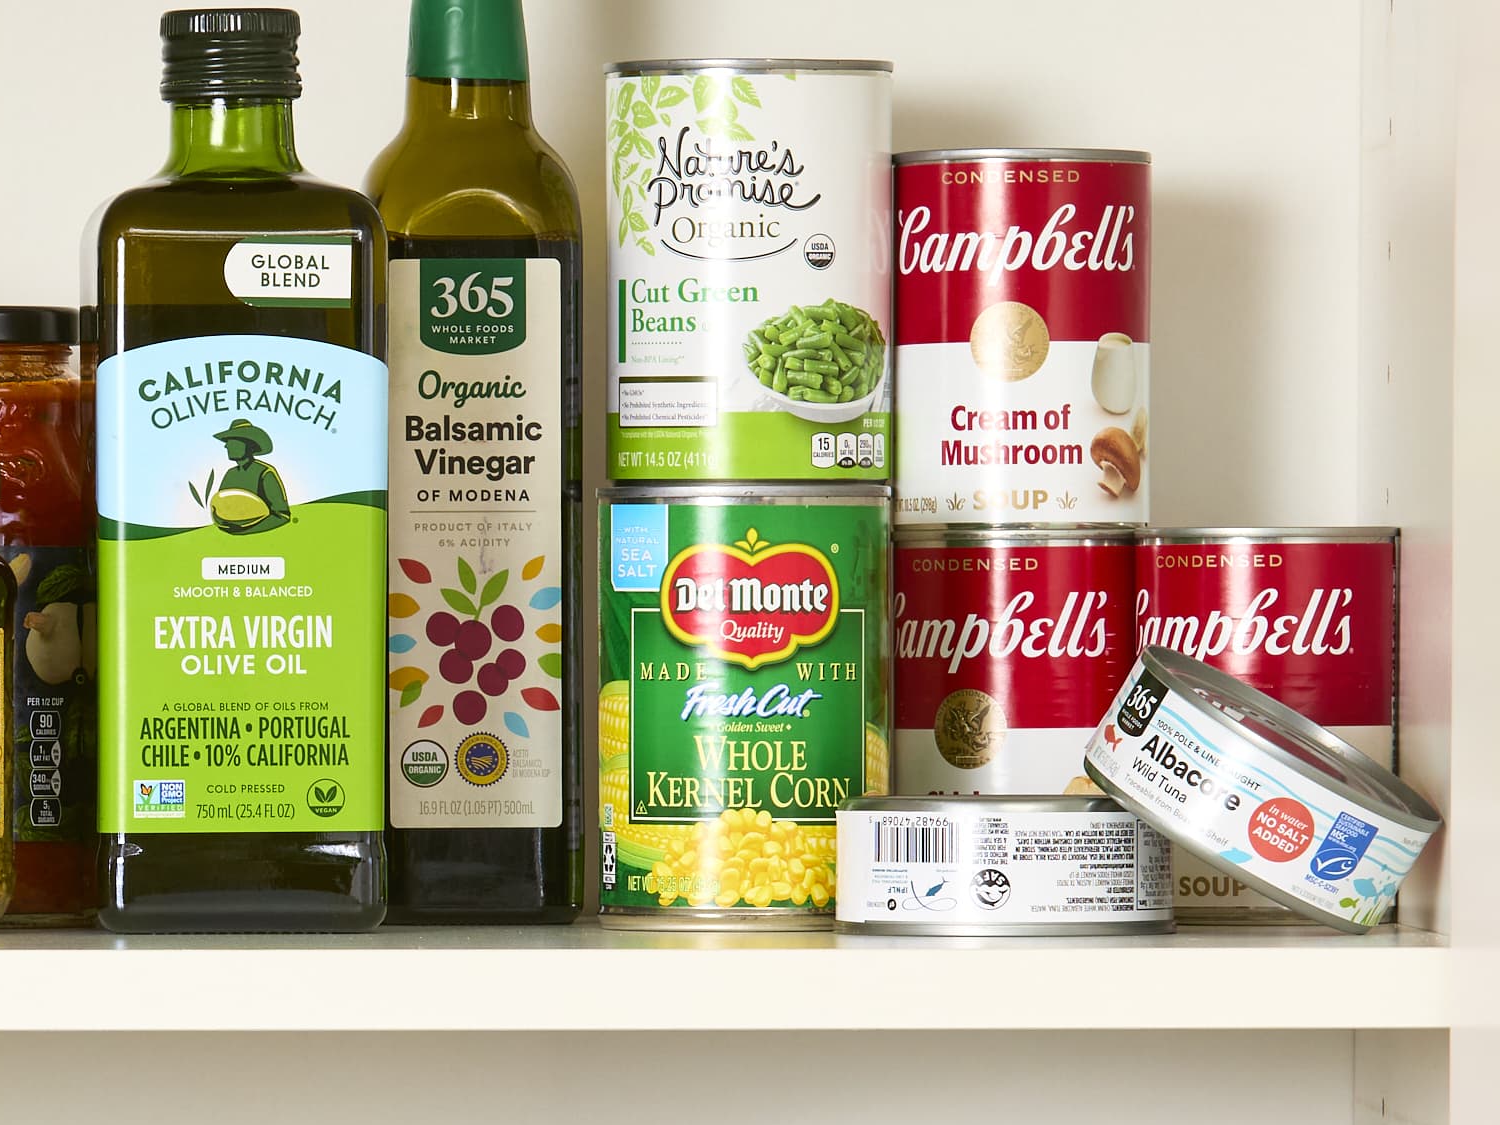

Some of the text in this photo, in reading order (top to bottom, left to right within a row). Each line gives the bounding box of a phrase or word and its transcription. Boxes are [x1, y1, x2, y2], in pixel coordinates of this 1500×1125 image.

[941, 170, 1080, 184] CONDENSED
[898, 203, 1135, 287] Campbell's
[251, 254, 330, 270] GLOBAL
[261, 273, 320, 288] BLEND
[631, 278, 669, 303] Cut
[430, 272, 514, 318] 365
[431, 325, 514, 333] WHOLE FOODS
[631, 309, 697, 333] Beans
[450, 336, 496, 344] MARKET
[138, 360, 341, 403] CALIFORNIA
[418, 370, 526, 408] Organic
[151, 389, 336, 430] OLIVE RANCH
[951, 404, 1070, 431] Cream of
[405, 415, 542, 442] Balsamic
[941, 440, 1082, 465] Mushroom
[415, 449, 535, 481] Vinegar
[417, 490, 530, 501] OF MODENA
[621, 548, 653, 562] SEA
[912, 558, 1039, 572] CONDENSED
[218, 564, 270, 575] MEDIUM
[618, 564, 657, 577] SALT
[173, 586, 313, 598] SMOOTH & BALANCED
[675, 577, 829, 613] Del Monte
[154, 615, 333, 649] EXTRA VIRGIN
[720, 619, 785, 643] Quality
[181, 654, 307, 675] OLIVE OIL
[1127, 685, 1157, 717] 365
[140, 716, 350, 740] ARGENTINA PORTUGAL
[141, 744, 349, 767] CHILE 10% CALIFORNIA
[412, 751, 438, 762] USDA
[694, 735, 807, 771] WHOLE
[408, 766, 442, 774] ORGANIC
[1131, 756, 1188, 803] Wild Tuna
[207, 784, 285, 793] COLD PRESSED
[646, 772, 850, 808] KERNEL CORN
[1256, 812, 1309, 845] NO SALT
[1269, 804, 1308, 830] in water
[1330, 829, 1349, 843] MSC
